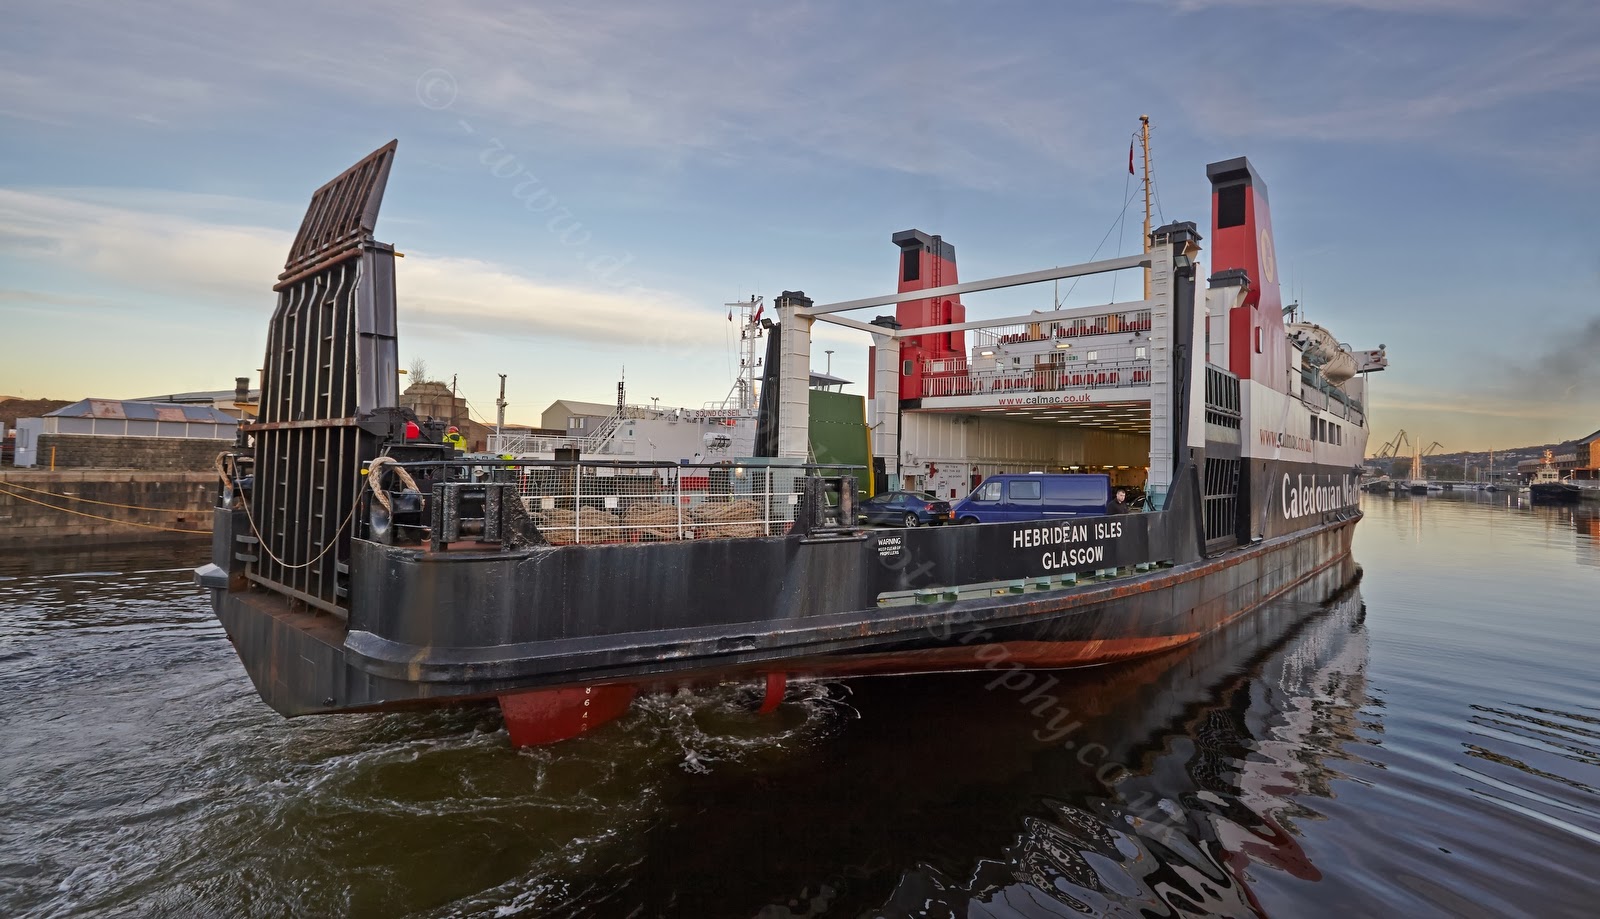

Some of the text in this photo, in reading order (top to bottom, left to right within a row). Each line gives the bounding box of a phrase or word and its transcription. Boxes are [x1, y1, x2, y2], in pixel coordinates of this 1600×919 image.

[998, 393, 1091, 405] www.calmac.co.uk
[695, 410, 717, 418] SOUND
[727, 409, 741, 417] SEIL
[1282, 472, 1341, 520] Caledonian
[878, 538, 901, 546] WARNING
[1013, 521, 1122, 549] HEBRIDEAN ISLES
[1042, 545, 1104, 570] GLASGOW
